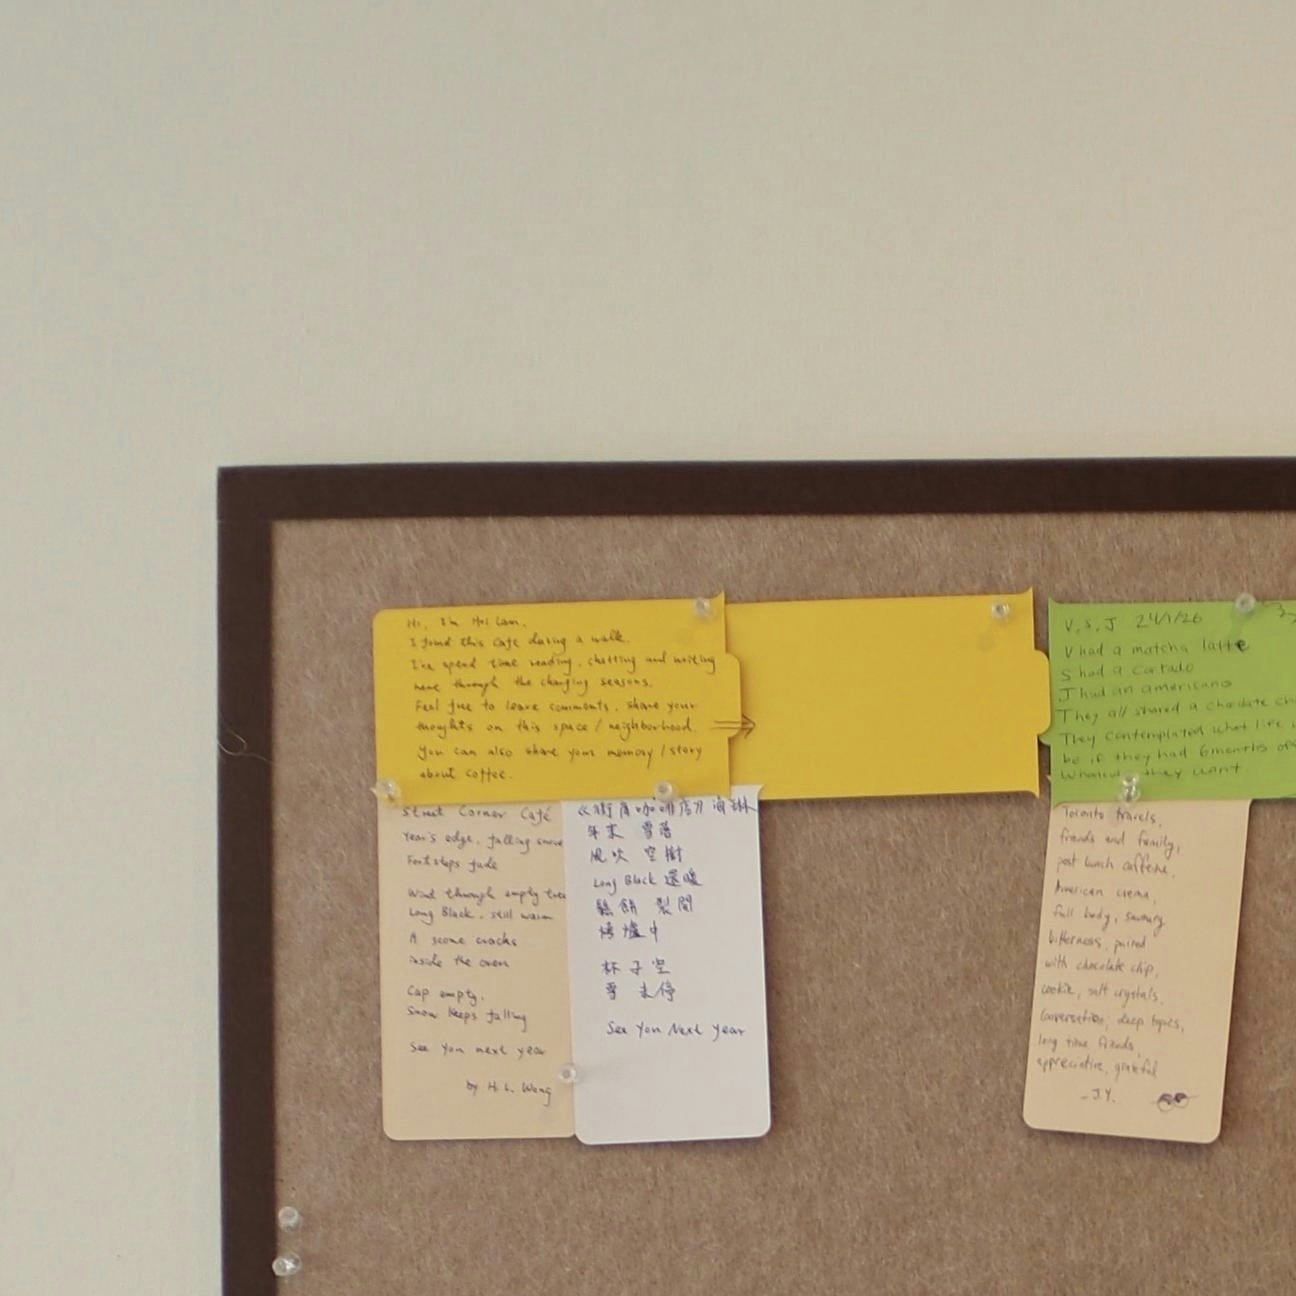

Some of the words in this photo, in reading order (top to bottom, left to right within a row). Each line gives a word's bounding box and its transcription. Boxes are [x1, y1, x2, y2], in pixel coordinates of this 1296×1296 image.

[410, 638, 416, 647] I
[421, 637, 451, 648] found
[460, 635, 484, 647] this
[528, 632, 566, 652] during
[1079, 643, 1104, 656] had
[1113, 647, 1121, 656] a
[1132, 641, 1188, 655] matcha
[1202, 640, 1248, 651] latte
[490, 658, 519, 669] time
[646, 651, 667, 663] and
[674, 655, 716, 674] writing
[1061, 670, 1072, 682] S
[1079, 665, 1104, 678] had
[1113, 666, 1122, 675] a
[453, 676, 498, 696] through
[515, 676, 531, 686] the
[540, 674, 588, 696] changing
[1080, 687, 1105, 698] had
[1113, 686, 1133, 695] an
[1141, 680, 1232, 692] americano
[415, 699, 439, 712] Feel
[448, 699, 472, 714] free
[482, 699, 495, 711] to
[505, 700, 539, 711] leave
[628, 697, 659, 710] share
[667, 702, 696, 714] your
[1055, 708, 1099, 725] They
[1108, 706, 1128, 718] all
[1135, 702, 1180, 717] shared
[1189, 704, 1198, 712] a
[416, 719, 473, 739] thoughts
[487, 724, 503, 732] on
[517, 720, 541, 732] this
[553, 723, 588, 737] space
[1060, 732, 1095, 748] They
[1213, 720, 1247, 735] what
[1256, 720, 1281, 729] life
[488, 746, 512, 757] also
[525, 744, 559, 757] share
[568, 748, 595, 763] your
[607, 749, 652, 770] memory
[671, 745, 703, 761] story
[1063, 753, 1079, 764] be
[1091, 752, 1104, 763] if
[1116, 752, 1151, 766] they
[1158, 747, 1187, 759] had
[420, 767, 455, 779] about
[458, 805, 505, 818] Corner
[1063, 805, 1104, 820] Toronto
[488, 833, 530, 854] falling
[1060, 827, 1095, 843] friends
[1105, 832, 1125, 846] and
[468, 857, 498, 872] fade
[1057, 854, 1077, 872] post
[1085, 856, 1114, 869] lunch
[593, 878, 617, 895] Long
[625, 872, 657, 885] Black
[408, 888, 436, 900] Wind
[446, 887, 496, 906] through
[505, 888, 539, 906] empty
[491, 909, 513, 919] still
[521, 912, 553, 920] warm
[1053, 904, 1073, 918] full
[1084, 907, 1118, 931] body,
[409, 932, 417, 944] A
[476, 932, 518, 946] cracks
[1114, 936, 1147, 954] paired
[409, 953, 443, 968] inside
[454, 955, 471, 967] the
[480, 959, 510, 968] oven
[1045, 954, 1068, 969] with
[1077, 958, 1125, 973] chocolate
[1088, 983, 1108, 996] salt
[407, 1006, 438, 1019] Snow
[487, 1009, 528, 1032] falling
[606, 1021, 628, 1035] See
[1117, 1013, 1144, 1031] deep
[410, 1042, 429, 1053] See
[475, 1045, 507, 1055] next
[518, 1046, 546, 1060] year
[1038, 1034, 1058, 1052] long
[1066, 1037, 1088, 1048] time
[522, 1082, 552, 1107] Wong
